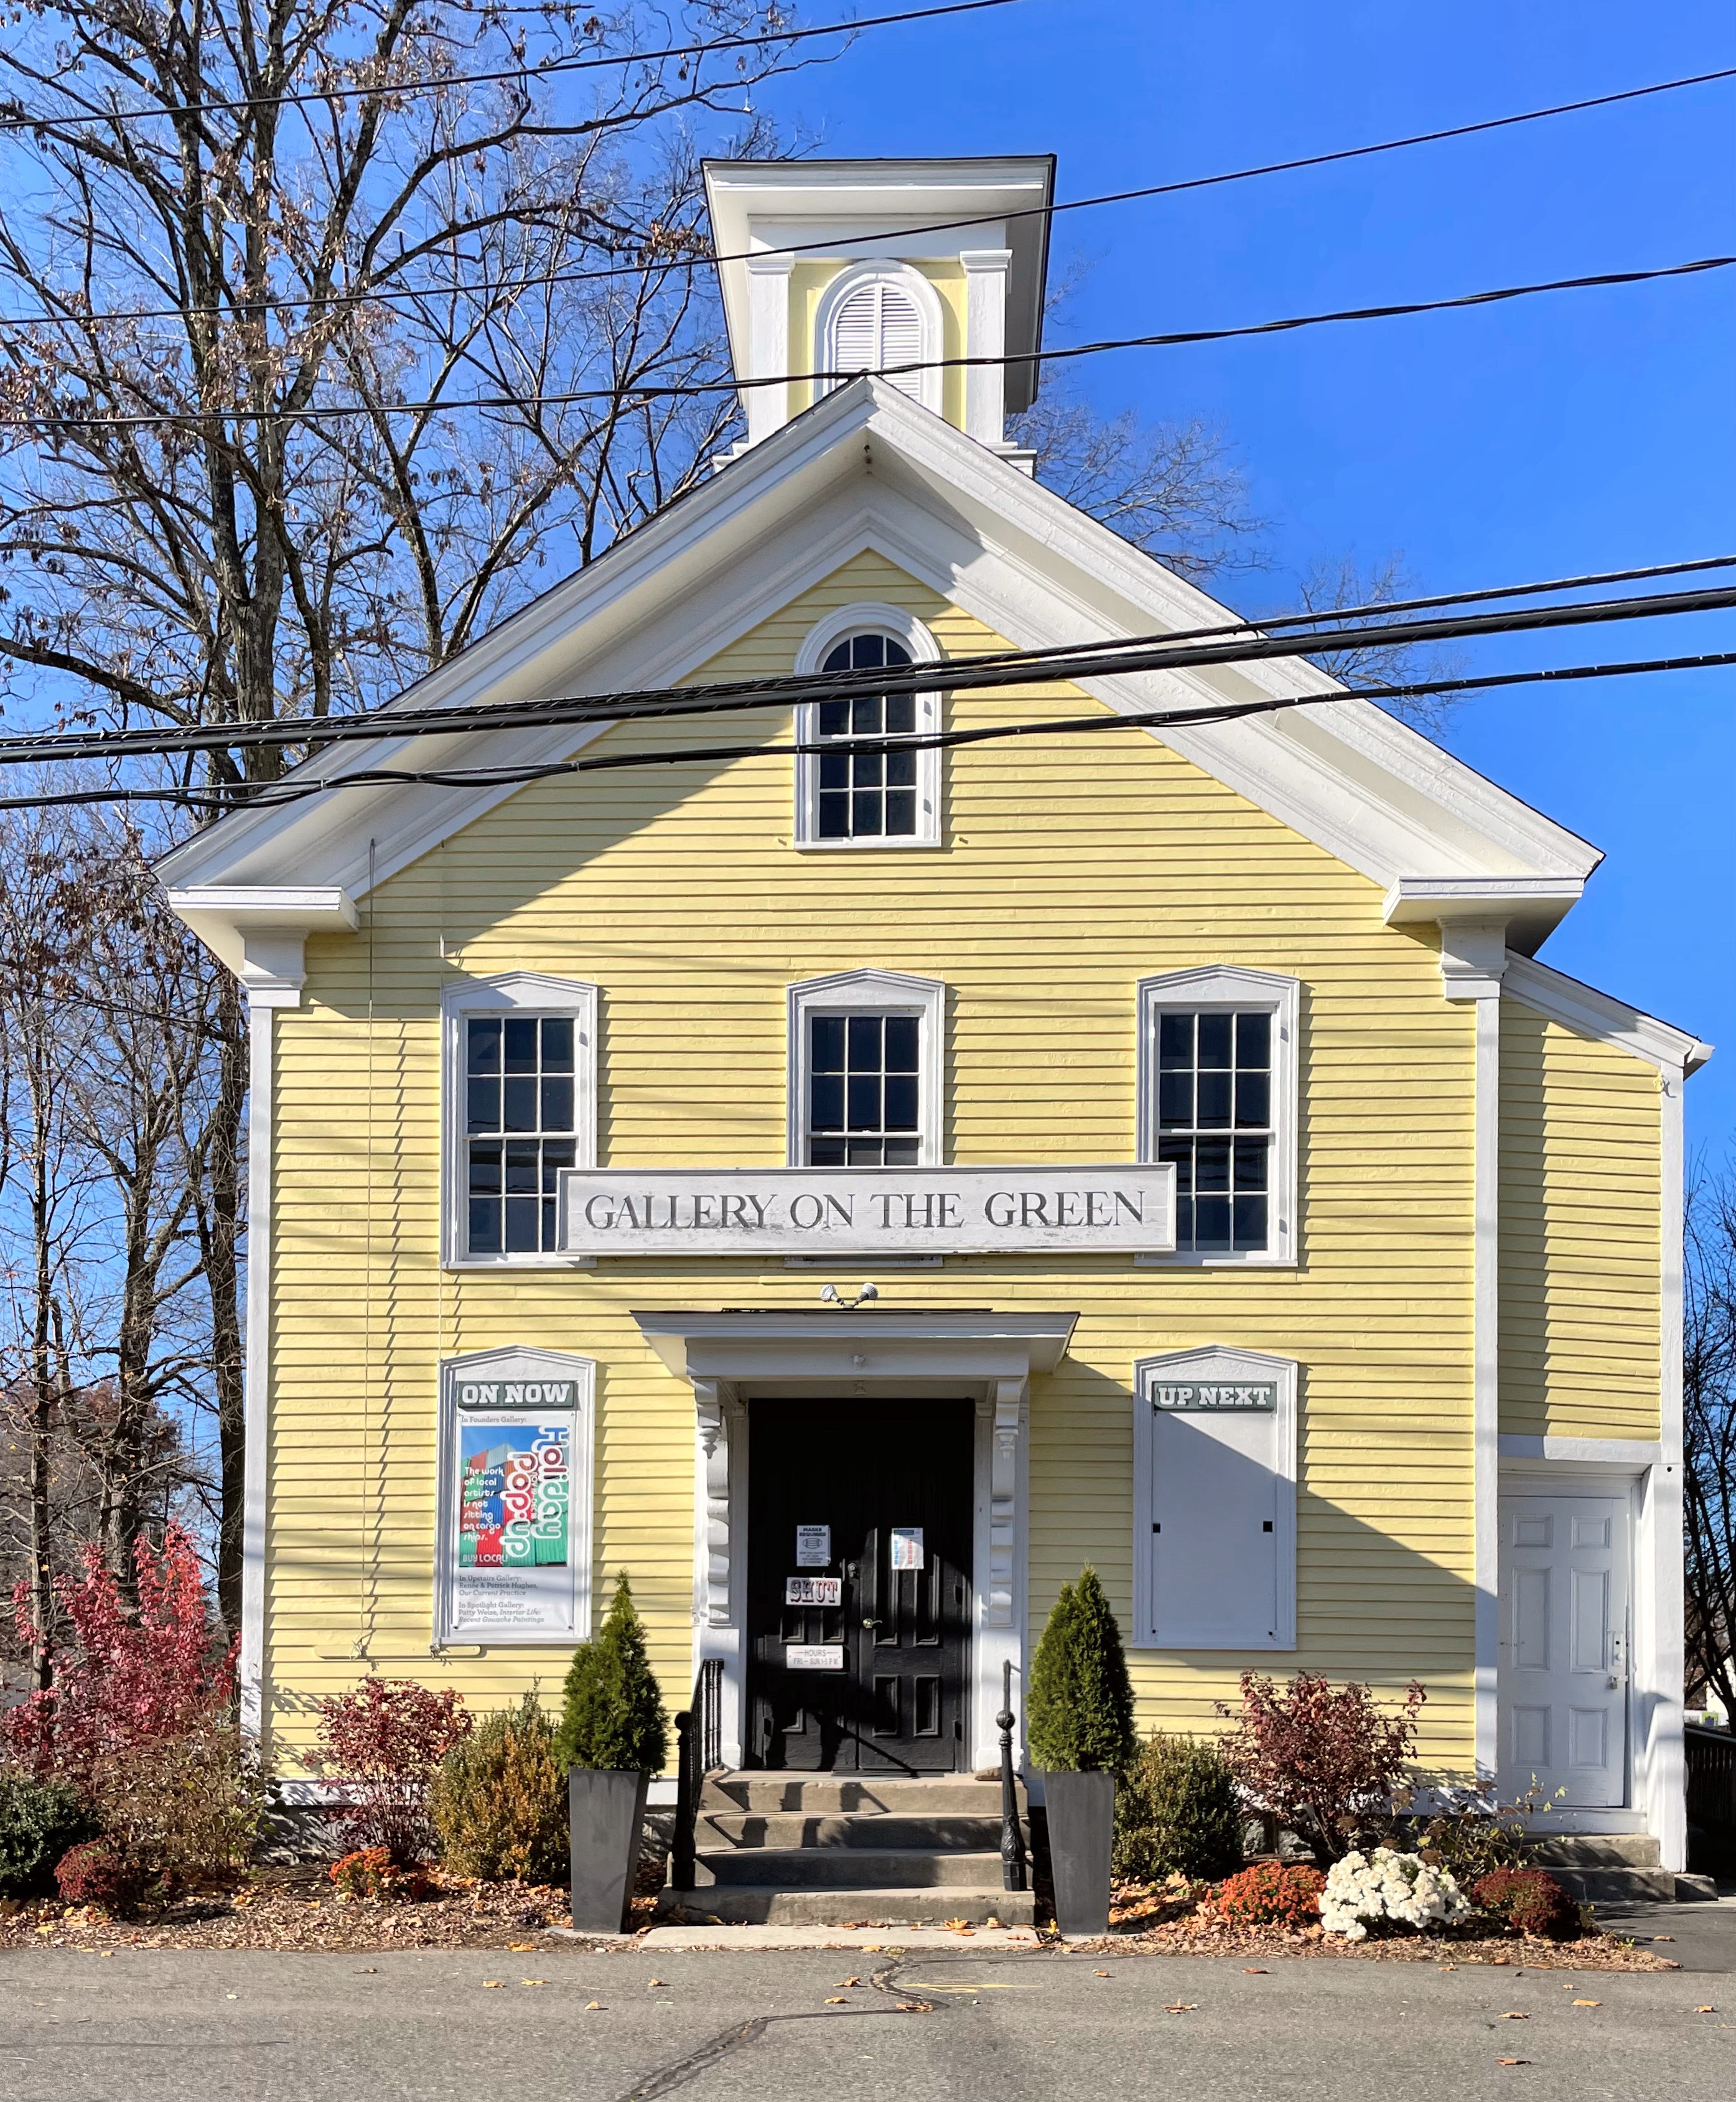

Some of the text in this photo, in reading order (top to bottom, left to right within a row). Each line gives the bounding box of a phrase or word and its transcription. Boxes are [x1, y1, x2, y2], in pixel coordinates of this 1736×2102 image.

[585, 1190, 1146, 1229] GALLERY ON THE GREEN
[462, 1383, 570, 1404] ON NOW
[1157, 1386, 1271, 1406] UP NEXT
[501, 1416, 527, 1424] Gallery:
[465, 1467, 505, 1477] The work
[477, 1478, 497, 1486] local
[531, 1426, 569, 1539] Holiday
[464, 1489, 495, 1497] artists
[472, 1500, 488, 1510] not
[464, 1511, 493, 1523] sitting
[464, 1523, 501, 1534] on cargo
[464, 1533, 488, 1543] ships.
[462, 1554, 478, 1563] BUY
[467, 1575, 495, 1583] Upstairs
[497, 1574, 523, 1582] Gallery:
[790, 1579, 838, 1603] SHUT
